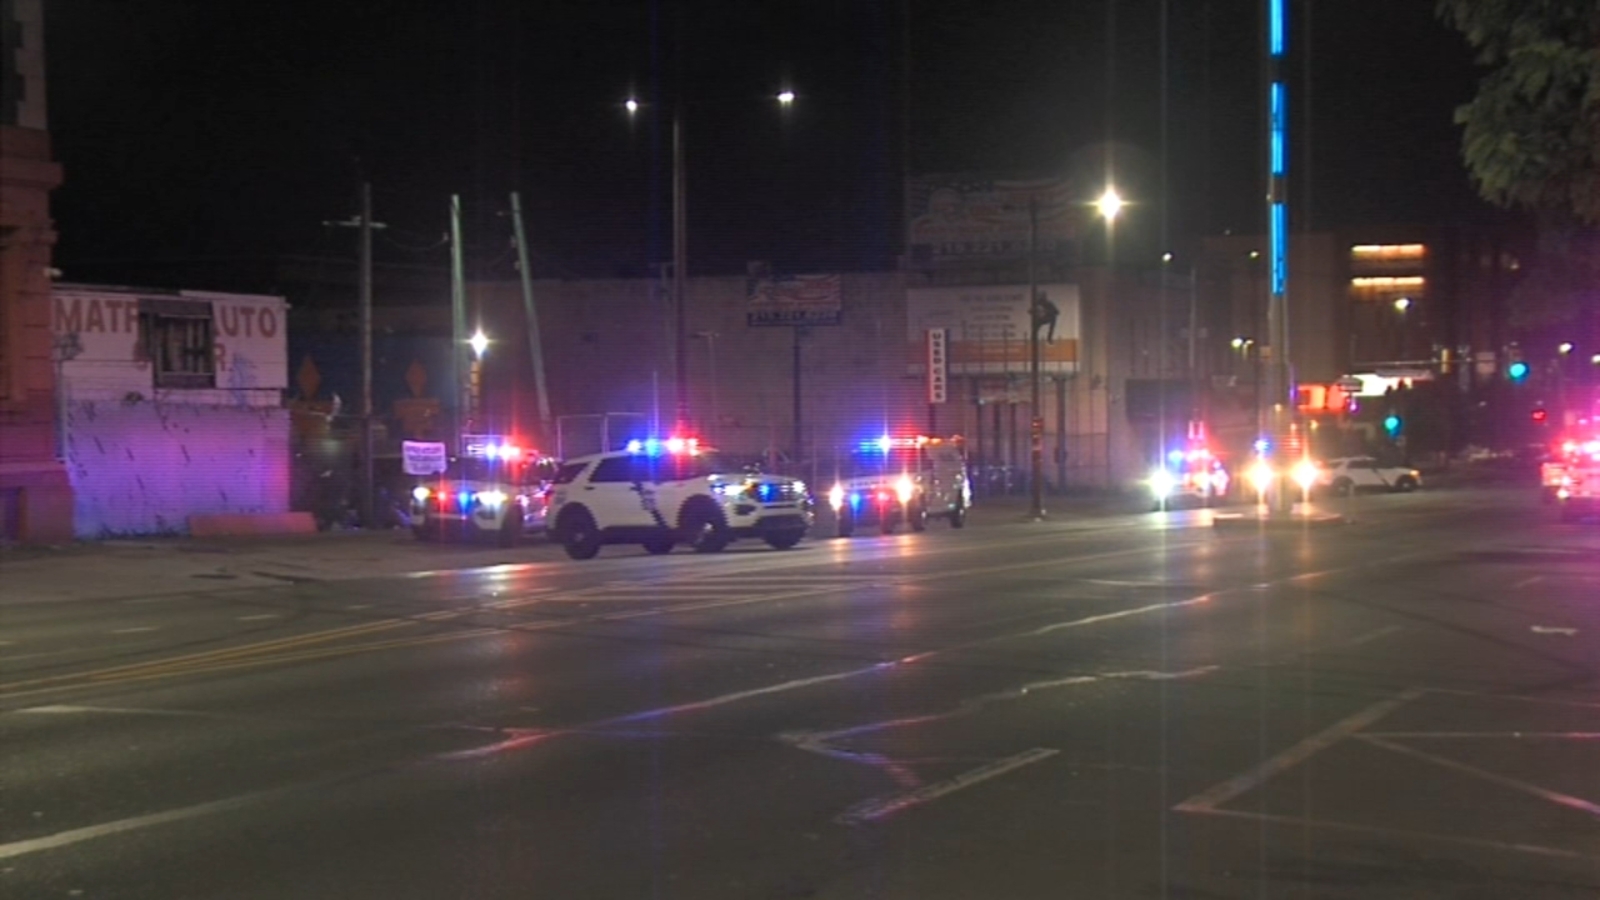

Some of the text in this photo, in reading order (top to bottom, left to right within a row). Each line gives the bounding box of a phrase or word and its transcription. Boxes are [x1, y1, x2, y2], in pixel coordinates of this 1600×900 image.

[214, 305, 277, 338] UTO
[931, 331, 943, 400] USED CARS
